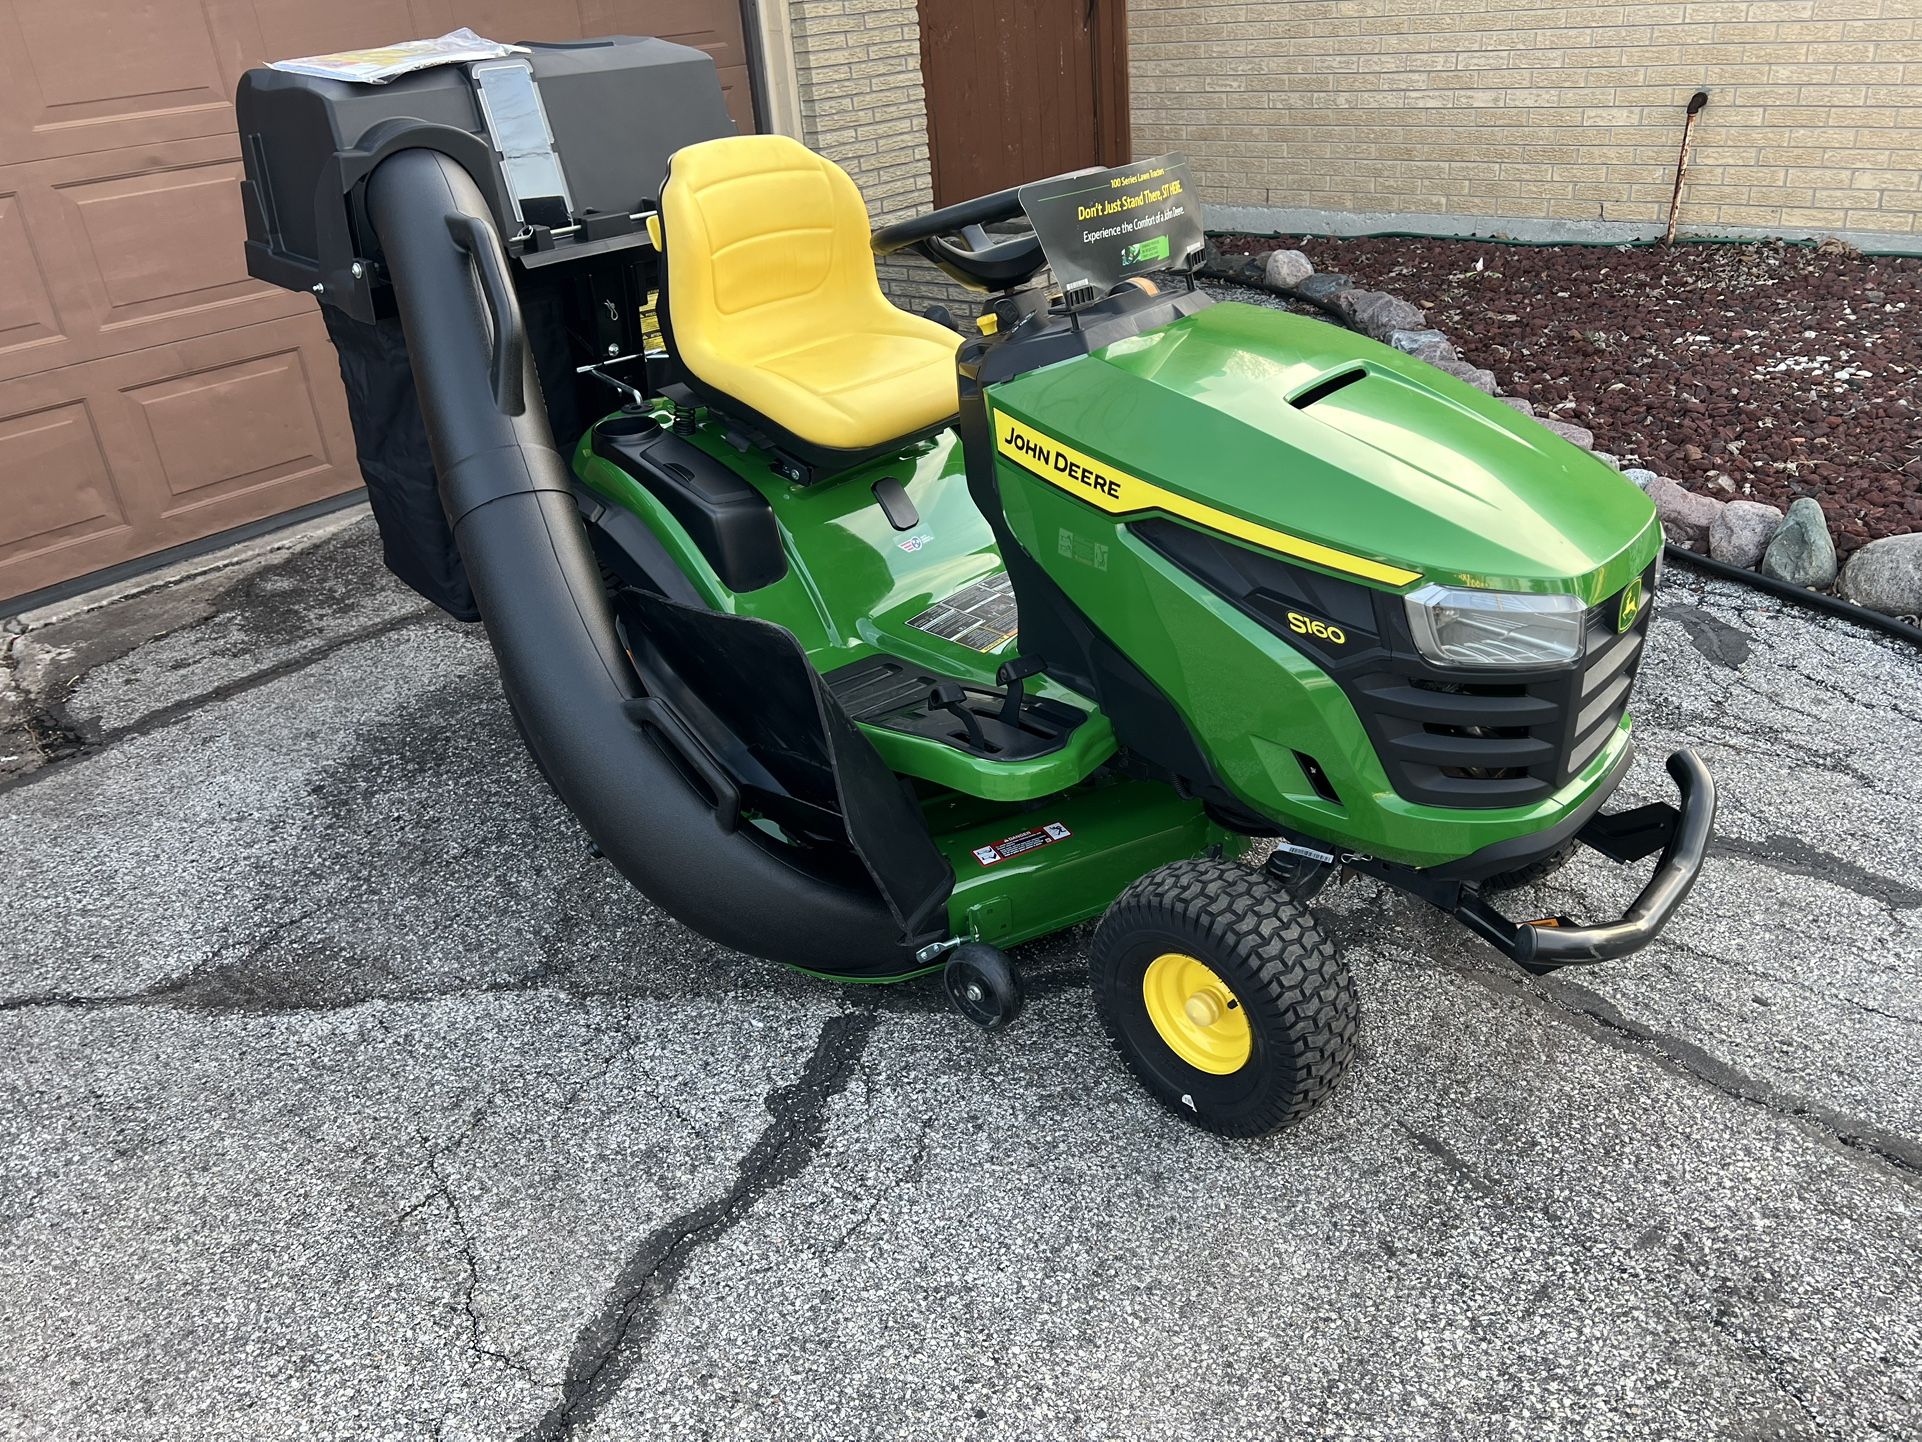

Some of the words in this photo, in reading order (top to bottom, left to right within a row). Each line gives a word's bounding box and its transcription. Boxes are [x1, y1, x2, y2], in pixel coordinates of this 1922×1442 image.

[1110, 178, 1121, 188] 100
[1121, 175, 1137, 186] Series
[1137, 173, 1150, 182] Lawn
[1149, 168, 1164, 178] Tractors
[1078, 203, 1102, 220] Don't
[1104, 199, 1121, 215] Just
[1122, 192, 1143, 210] Stand
[1144, 189, 1163, 203] There,
[1162, 183, 1170, 198] SIT
[1169, 180, 1183, 195] HERE.
[1083, 227, 1121, 244] Experience
[1121, 221, 1133, 234] the
[1133, 215, 1156, 231] Comfort
[1155, 211, 1161, 224] of
[1163, 210, 1173, 221] John
[1173, 206, 1184, 218] Deere.
[1004, 426, 1051, 466] JOHN
[1053, 450, 1121, 500] DEERE
[1287, 612, 1346, 645] S160
[1007, 831, 1032, 841] DANGER
